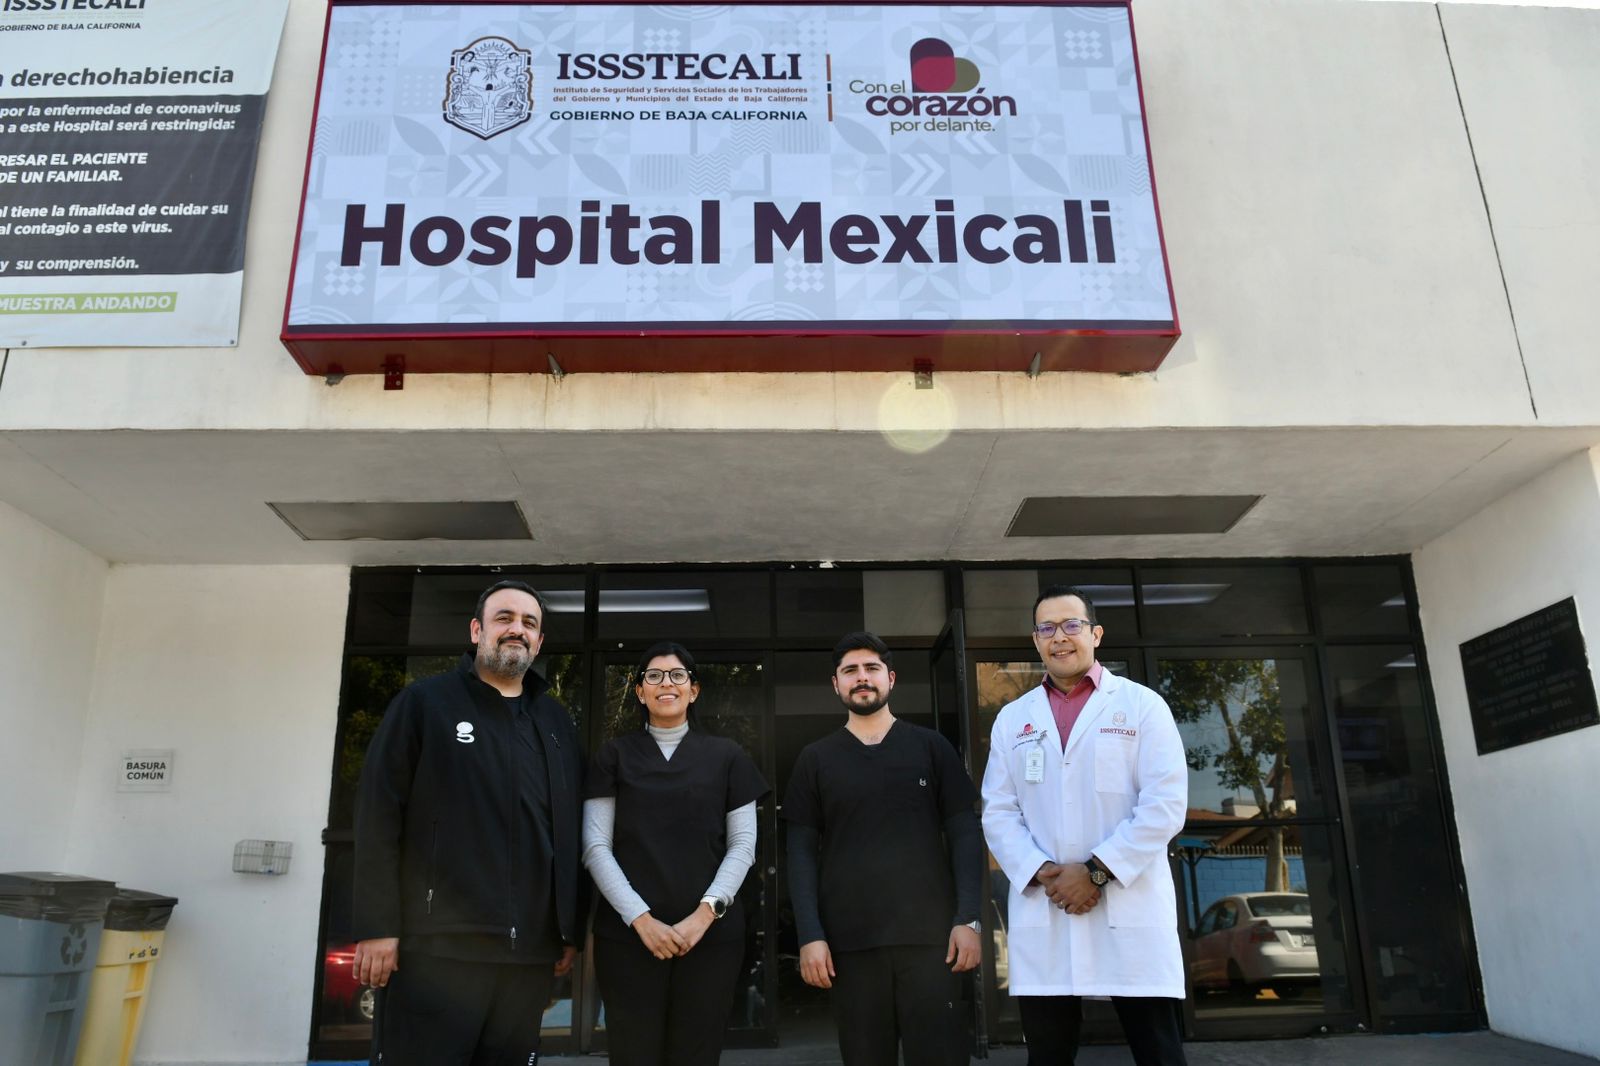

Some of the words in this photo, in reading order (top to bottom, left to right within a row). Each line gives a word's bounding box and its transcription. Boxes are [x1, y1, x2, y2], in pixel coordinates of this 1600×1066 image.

[0, 23, 45, 32] GOBIERNO
[47, 23, 60, 31] DE
[61, 22, 85, 31] BAJA
[86, 21, 141, 30] CALIFORNIA
[557, 52, 803, 80] ISSSTECALI
[11, 66, 234, 87] derechohabiencia
[553, 86, 589, 94] Instituto
[602, 86, 645, 95] Seguridad
[653, 86, 691, 94] Servicios
[692, 86, 727, 94] Sociales
[755, 86, 808, 95] Trabajadores
[849, 79, 887, 94] Con
[890, 80, 906, 94] el
[625, 95, 671, 103] Municipios
[744, 95, 762, 103] Baja
[865, 87, 1017, 116] corazón
[0, 107, 25, 118] por
[27, 105, 41, 116] la
[44, 104, 131, 116] enfermedad
[134, 103, 153, 115] de
[156, 102, 242, 114] coronavirus
[549, 110, 635, 121] GOBIERNO
[640, 110, 660, 120] DE
[666, 110, 707, 120] BAJA
[711, 110, 808, 121] CALIFORNIA
[8, 123, 17, 133] a
[20, 121, 51, 133] este
[53, 120, 114, 133] Hospital
[116, 119, 147, 131] será
[150, 118, 235, 132] restringida:
[890, 119, 918, 135] por
[924, 118, 996, 132] delante.
[0, 154, 48, 166] RESAR
[50, 153, 69, 165] EL
[72, 152, 148, 165] PACIENTE
[0, 170, 18, 183] DE
[21, 171, 44, 183] UN
[46, 169, 123, 182] FAMILIAR.
[11, 205, 48, 217] tiene
[51, 204, 65, 216] la
[68, 203, 135, 216] finalidad
[138, 203, 157, 216] de
[160, 203, 208, 215] cuidar
[211, 204, 229, 214] su
[14, 222, 80, 236] contagio
[82, 223, 92, 233] a
[95, 221, 128, 233] este
[340, 200, 721, 278] Hospital
[753, 199, 1116, 264] Mexicali
[0, 260, 10, 272] y
[16, 260, 34, 270] su
[36, 256, 139, 272] comprensión.
[80, 295, 171, 310] ANDANDO
[126, 761, 166, 770] BASURA
[126, 769, 164, 780] COMÚN
